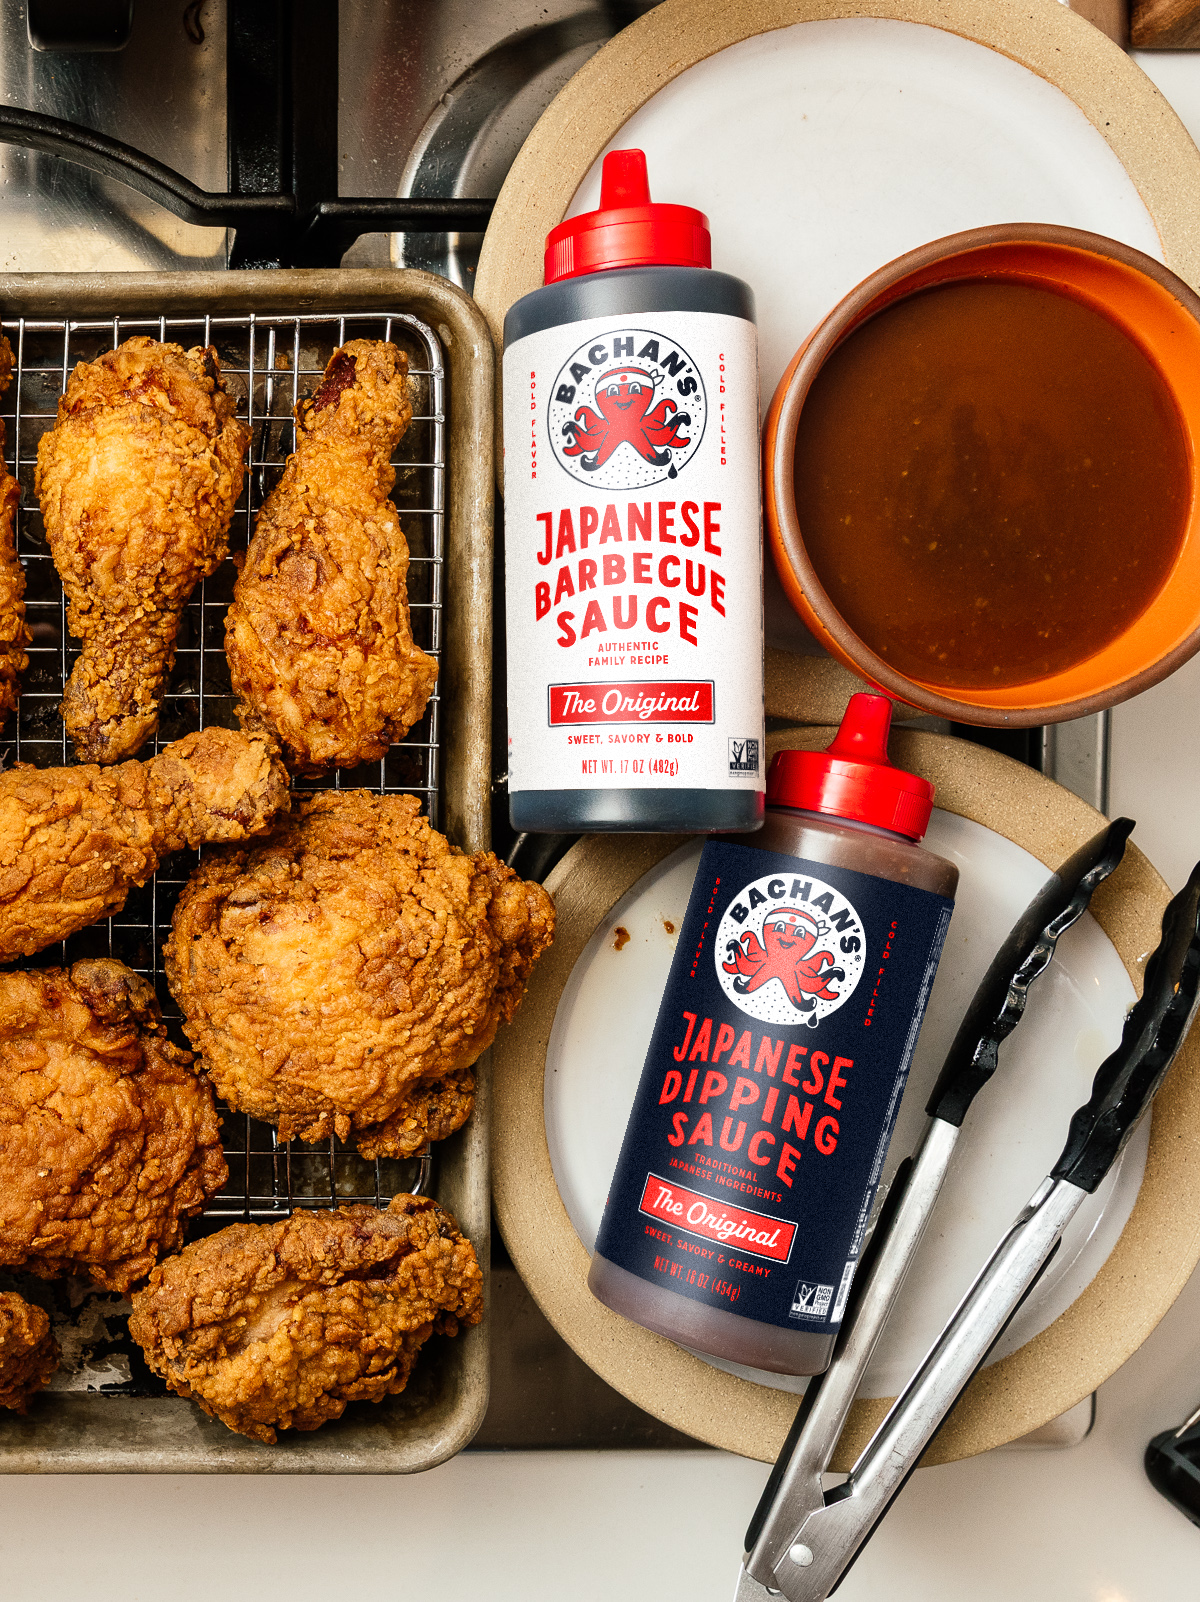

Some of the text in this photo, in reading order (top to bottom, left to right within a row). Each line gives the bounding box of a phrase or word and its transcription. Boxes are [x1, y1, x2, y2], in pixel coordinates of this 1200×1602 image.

[555, 336, 698, 405] BACHAN'S
[536, 500, 722, 566] JAPANESE
[535, 552, 726, 622] BARBECUE
[556, 594, 699, 648] SAUCE
[597, 641, 659, 653] AUTHENTIC
[588, 654, 669, 667] FAMILY RECIPE
[562, 689, 700, 720] The Original
[567, 733, 694, 745] SWEET, SAVORY & BOLD
[581, 757, 679, 777] NET WT. 17 OZ (482g)
[689, 877, 721, 978] BOLD FLAVOR
[729, 878, 862, 955] BACHAN'S
[864, 920, 898, 1027] COLD FILLED
[673, 1010, 854, 1111] JAPANESE
[658, 1068, 840, 1156] DIPPING
[667, 1111, 802, 1189] SAUCE
[694, 1152, 758, 1182] TRADITIONAL
[668, 1156, 783, 1203] JAPANESE INGREDIENTS
[652, 1185, 782, 1248] The Original
[644, 1225, 772, 1278] SWEET, SAVORY & CREAMY
[653, 1254, 741, 1302] NET WT. 16 OZ (454g)
[819, 1287, 831, 1295] NON
